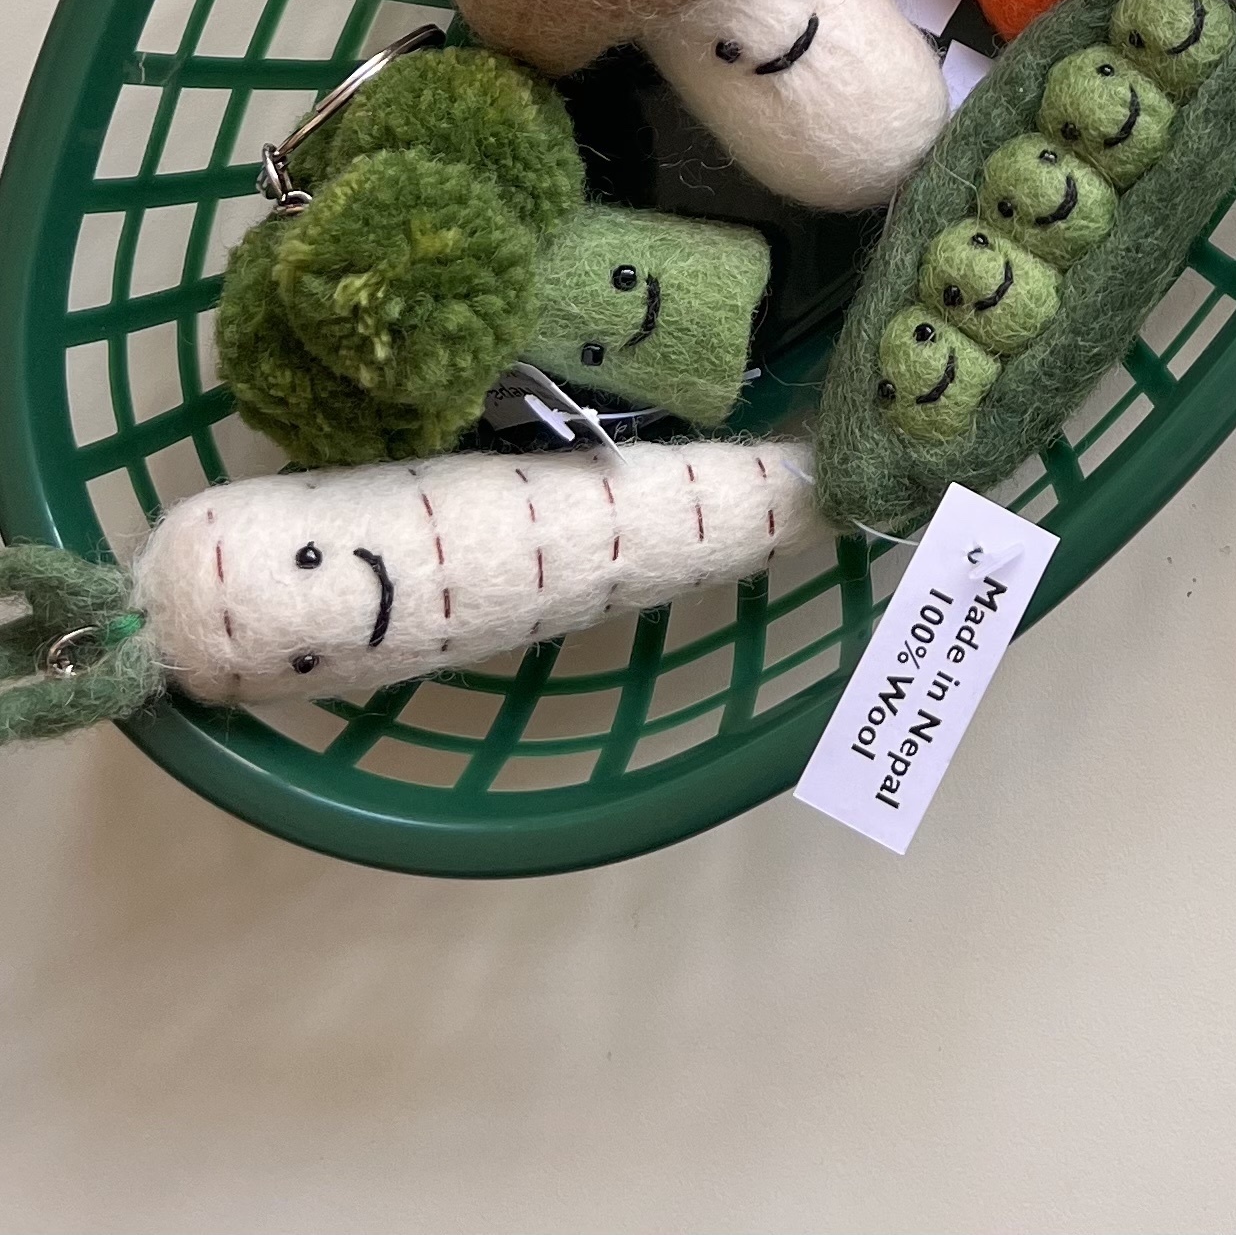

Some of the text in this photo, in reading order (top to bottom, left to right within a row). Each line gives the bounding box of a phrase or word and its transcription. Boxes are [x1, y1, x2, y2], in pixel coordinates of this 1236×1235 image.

[851, 588, 954, 760] 100% Wool
[875, 576, 1008, 809] Made in Nepal
